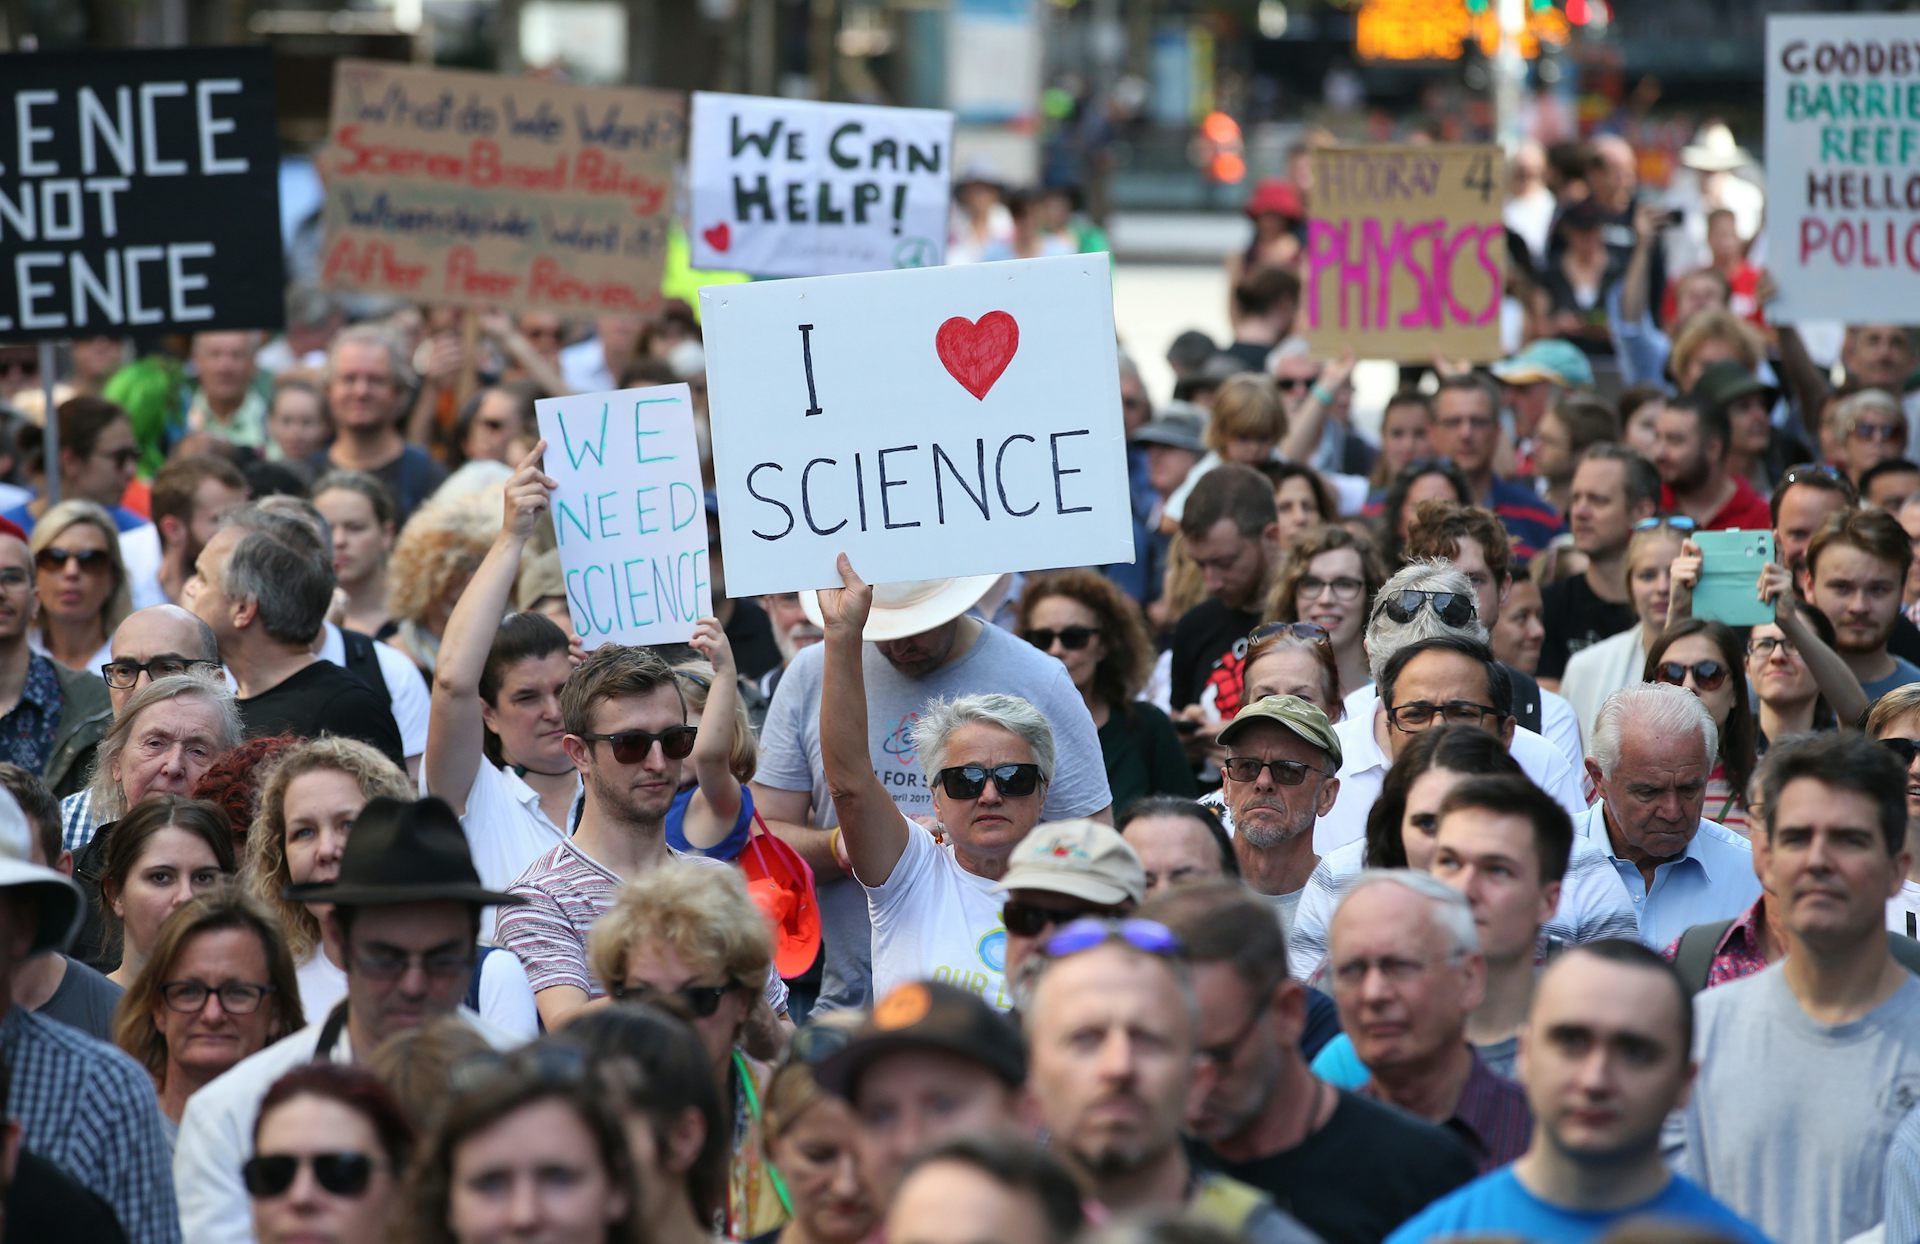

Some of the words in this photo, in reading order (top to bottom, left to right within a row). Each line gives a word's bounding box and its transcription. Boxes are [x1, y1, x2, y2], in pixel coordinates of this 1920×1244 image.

[0, 79, 250, 176] ENCE
[729, 114, 806, 161] WE
[827, 121, 941, 174] CAN
[0, 178, 131, 242] NOT
[732, 175, 908, 236] HELP!
[1462, 153, 1496, 204] 4
[1807, 170, 1920, 211] HELLO
[0, 242, 215, 332] ENCE
[1308, 217, 1505, 331] PHYSICS
[798, 324, 823, 417] I
[557, 398, 682, 470] WE
[556, 482, 697, 546] NEED
[746, 429, 1093, 541] SCIENCE
[566, 549, 706, 637] SCIENCE
[884, 770, 917, 787] FOR
[910, 794, 931, 804] 2017
